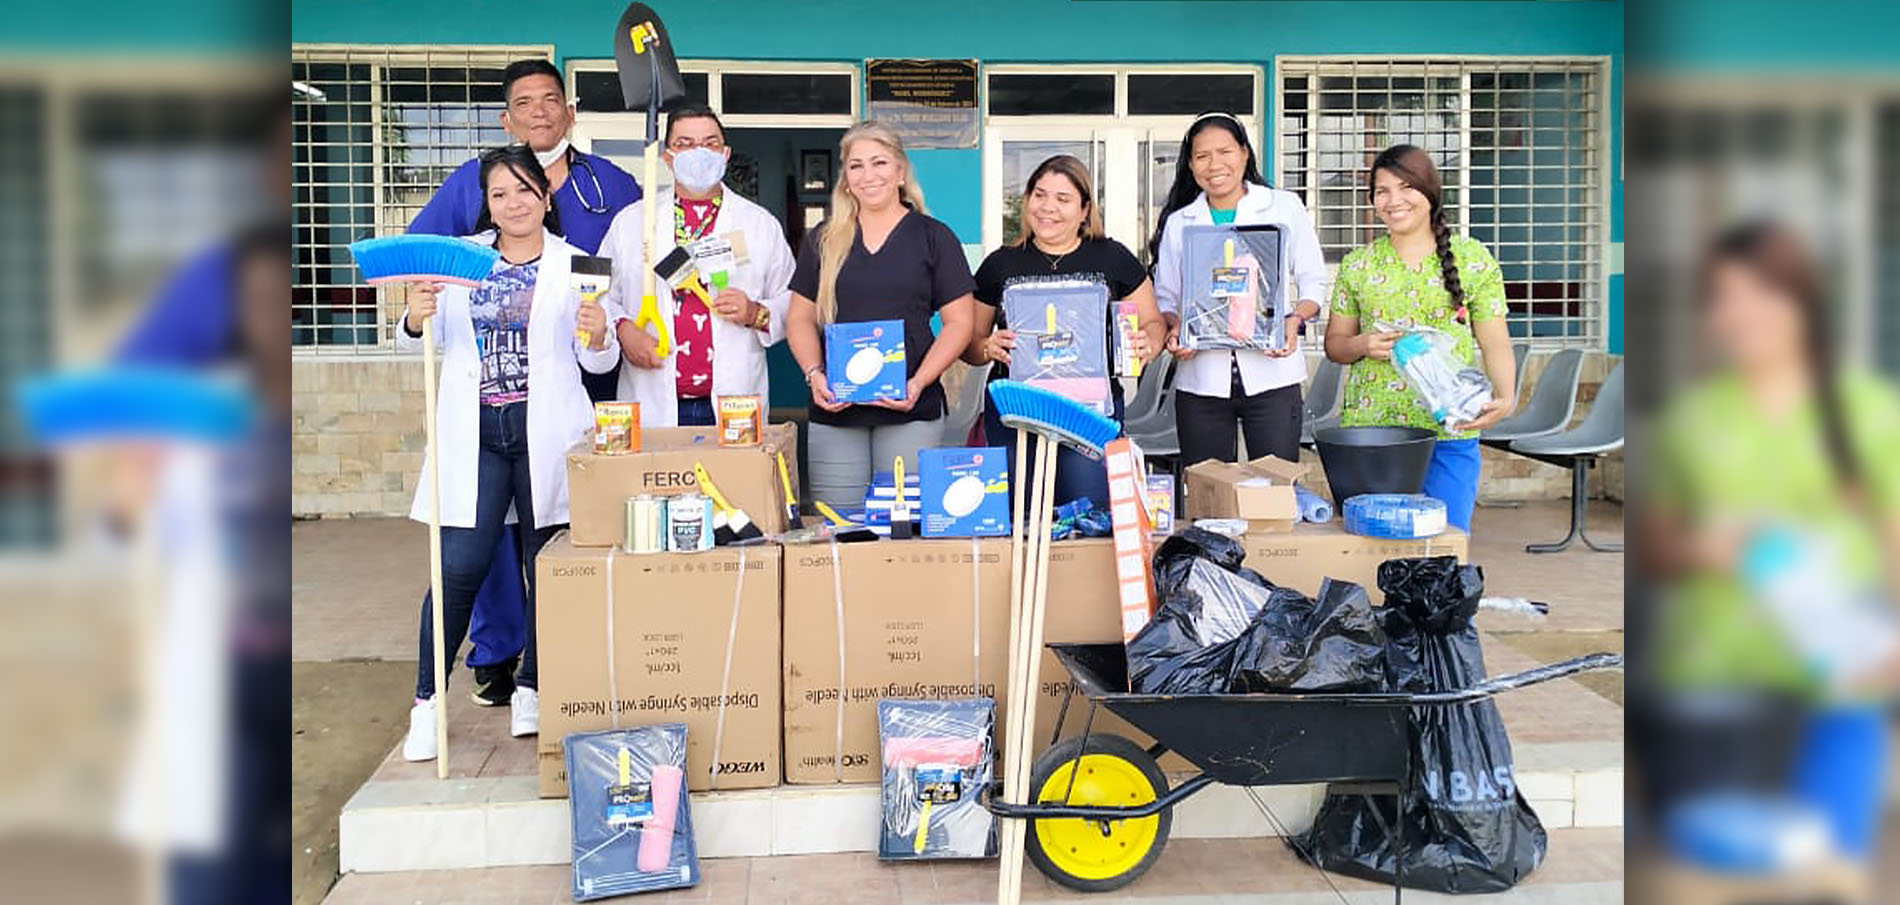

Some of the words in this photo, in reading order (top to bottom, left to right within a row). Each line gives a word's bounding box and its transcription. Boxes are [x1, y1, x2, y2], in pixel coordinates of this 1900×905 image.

[852, 687, 879, 703] with
[881, 682, 927, 698] Syringe
[560, 700, 606, 718] Needle
[639, 695, 687, 715] Syringe
[708, 761, 766, 776] WEGO
[1450, 764, 1515, 801] BAS
